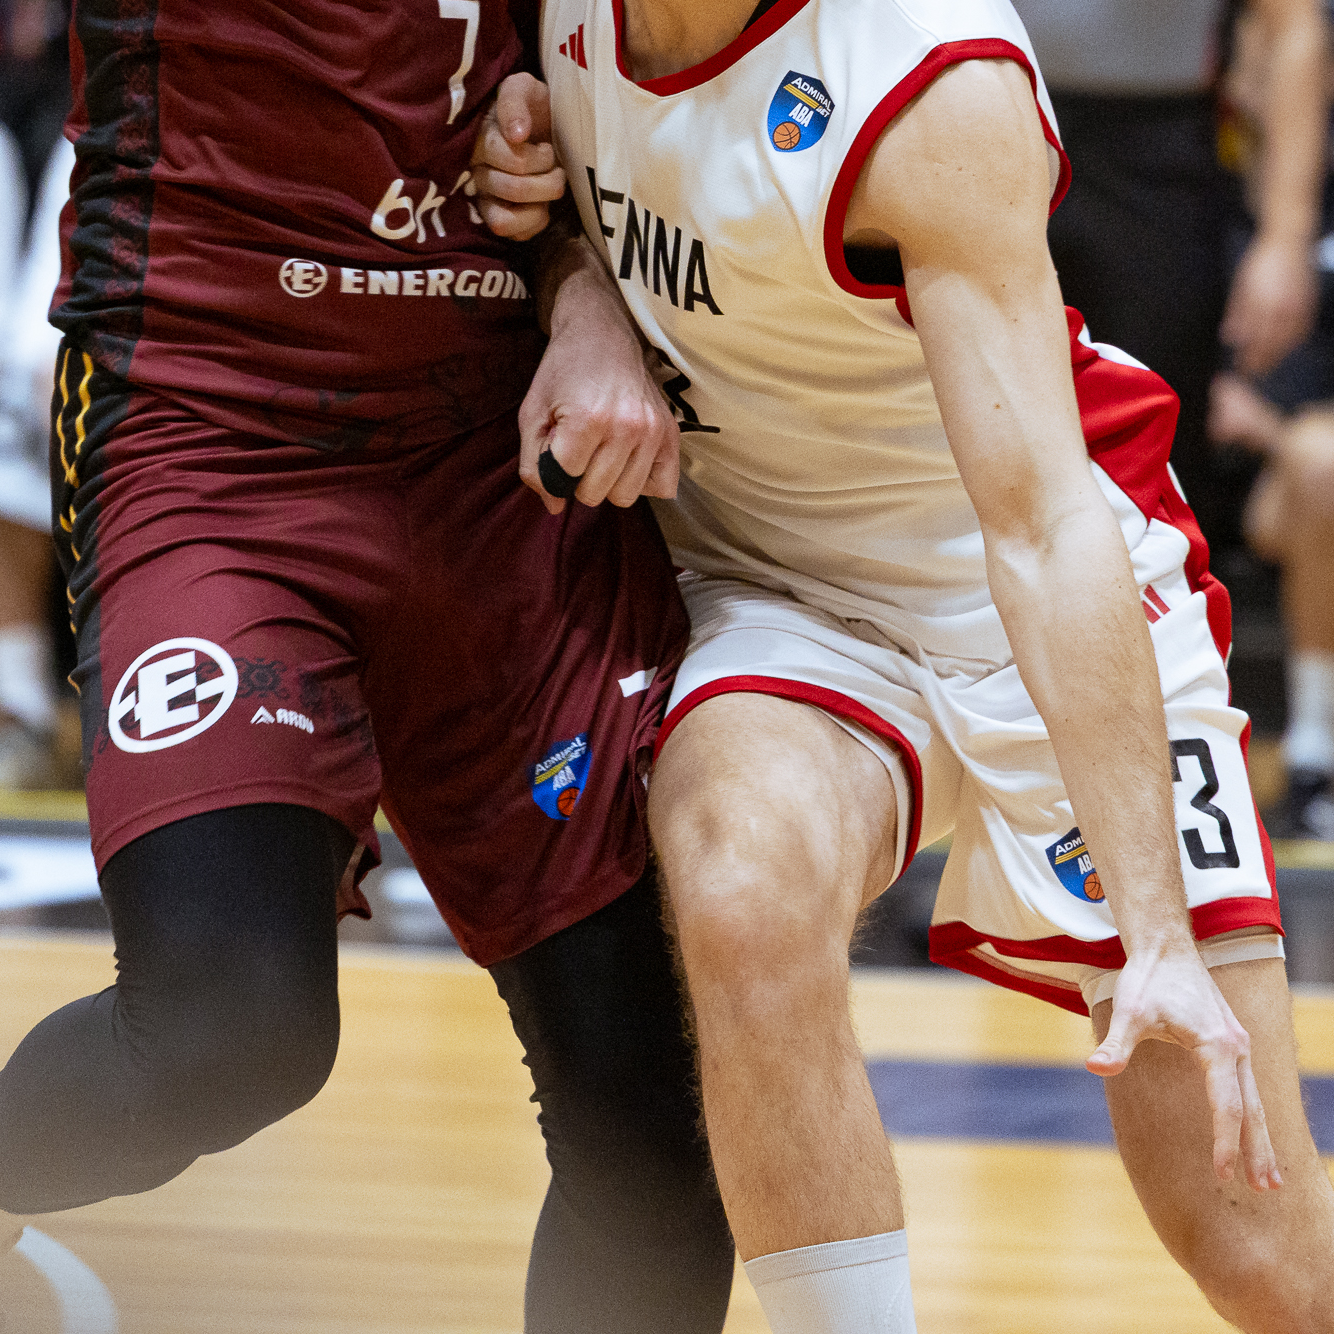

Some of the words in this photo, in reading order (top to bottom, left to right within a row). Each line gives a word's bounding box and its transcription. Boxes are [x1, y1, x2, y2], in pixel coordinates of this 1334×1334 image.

[438, 0, 480, 125] 7
[791, 77, 832, 112] ADMIRAL
[788, 103, 814, 127] ABA
[1169, 738, 1240, 869] 3
